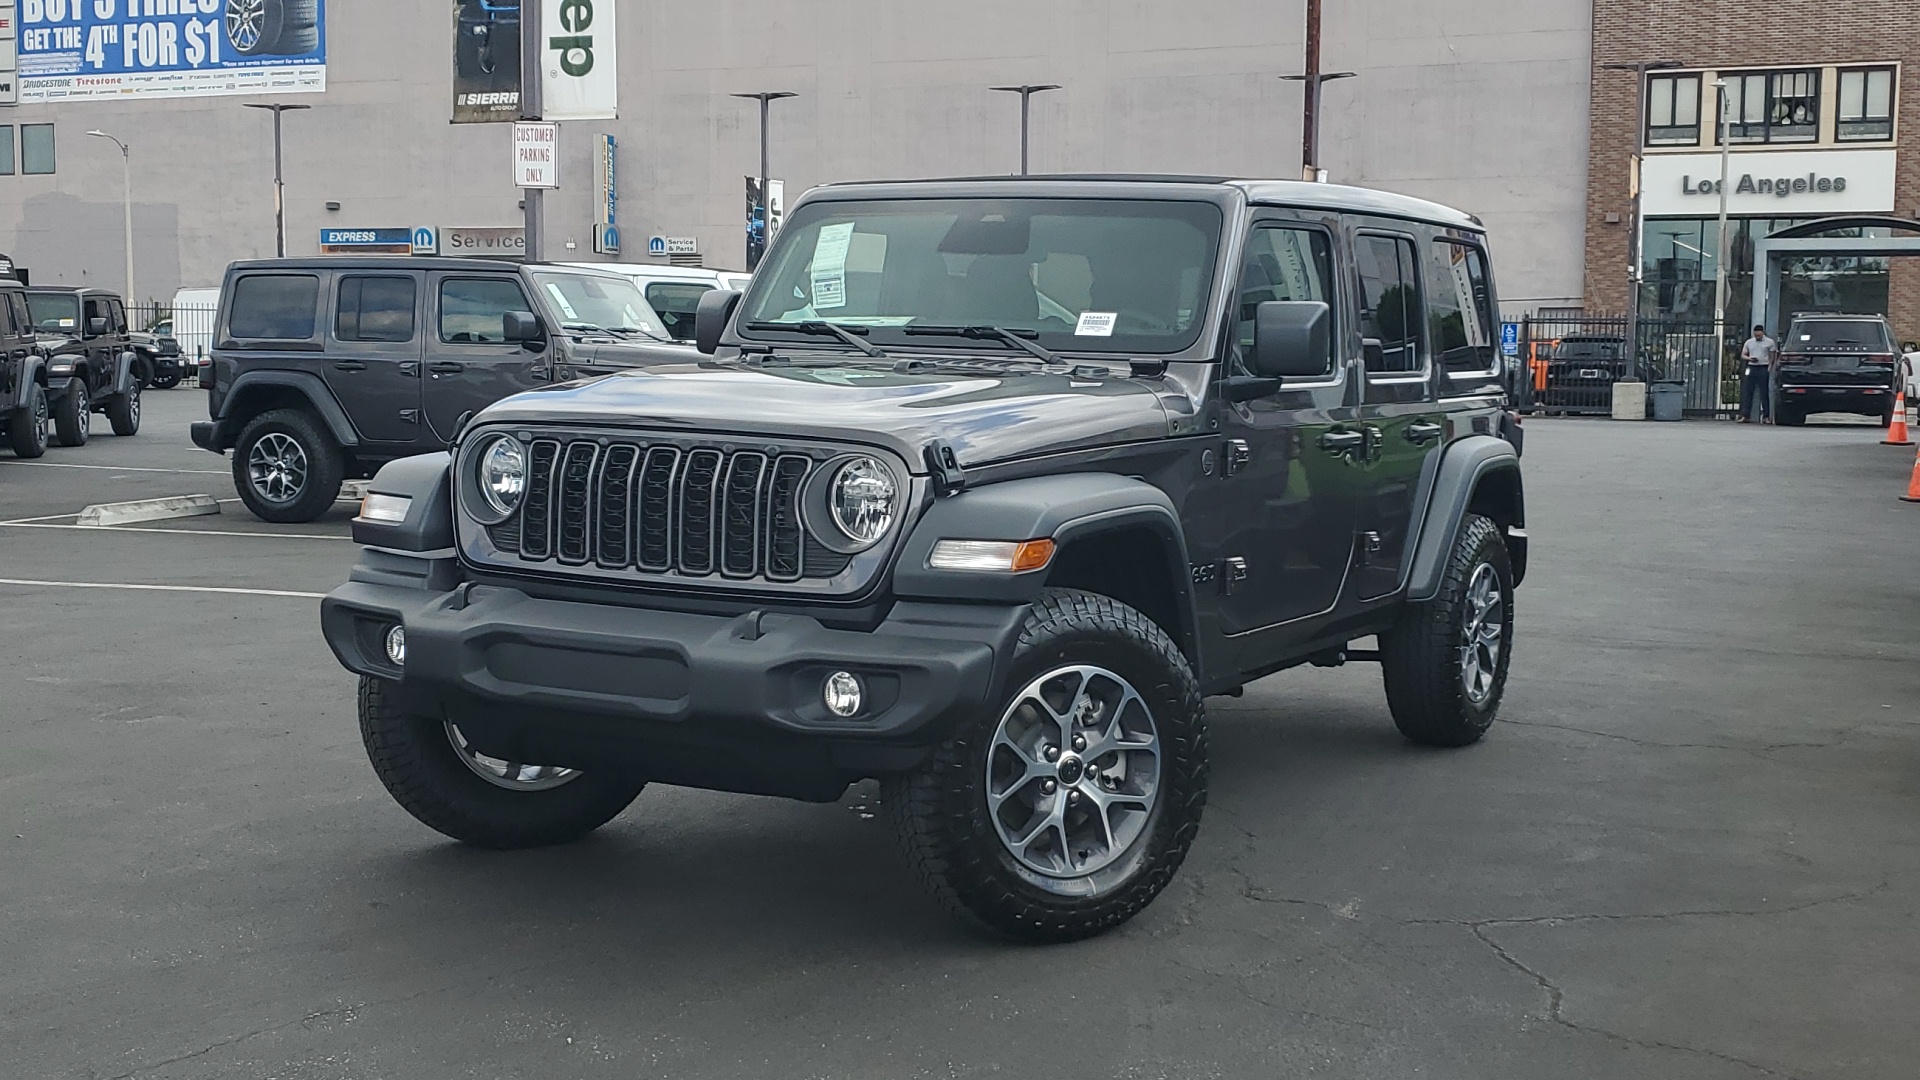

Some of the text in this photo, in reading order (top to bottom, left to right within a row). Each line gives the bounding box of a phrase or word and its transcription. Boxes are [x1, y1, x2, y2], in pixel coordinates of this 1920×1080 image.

[23, 28, 51, 51] GET
[53, 26, 82, 49] THE
[123, 22, 178, 67] FOR
[184, 17, 219, 68] $1
[23, 78, 72, 89] BRIDGESTONE
[75, 77, 122, 87] Firestone
[466, 92, 519, 105] SIERRA
[516, 127, 554, 142] CUSTOMER
[520, 147, 550, 162] PARKING
[526, 167, 543, 182] ONLY
[1735, 172, 1847, 198] Angeles
[770, 198, 782, 241] Je
[329, 231, 376, 242] EXPRESS
[450, 233, 525, 248] Service
